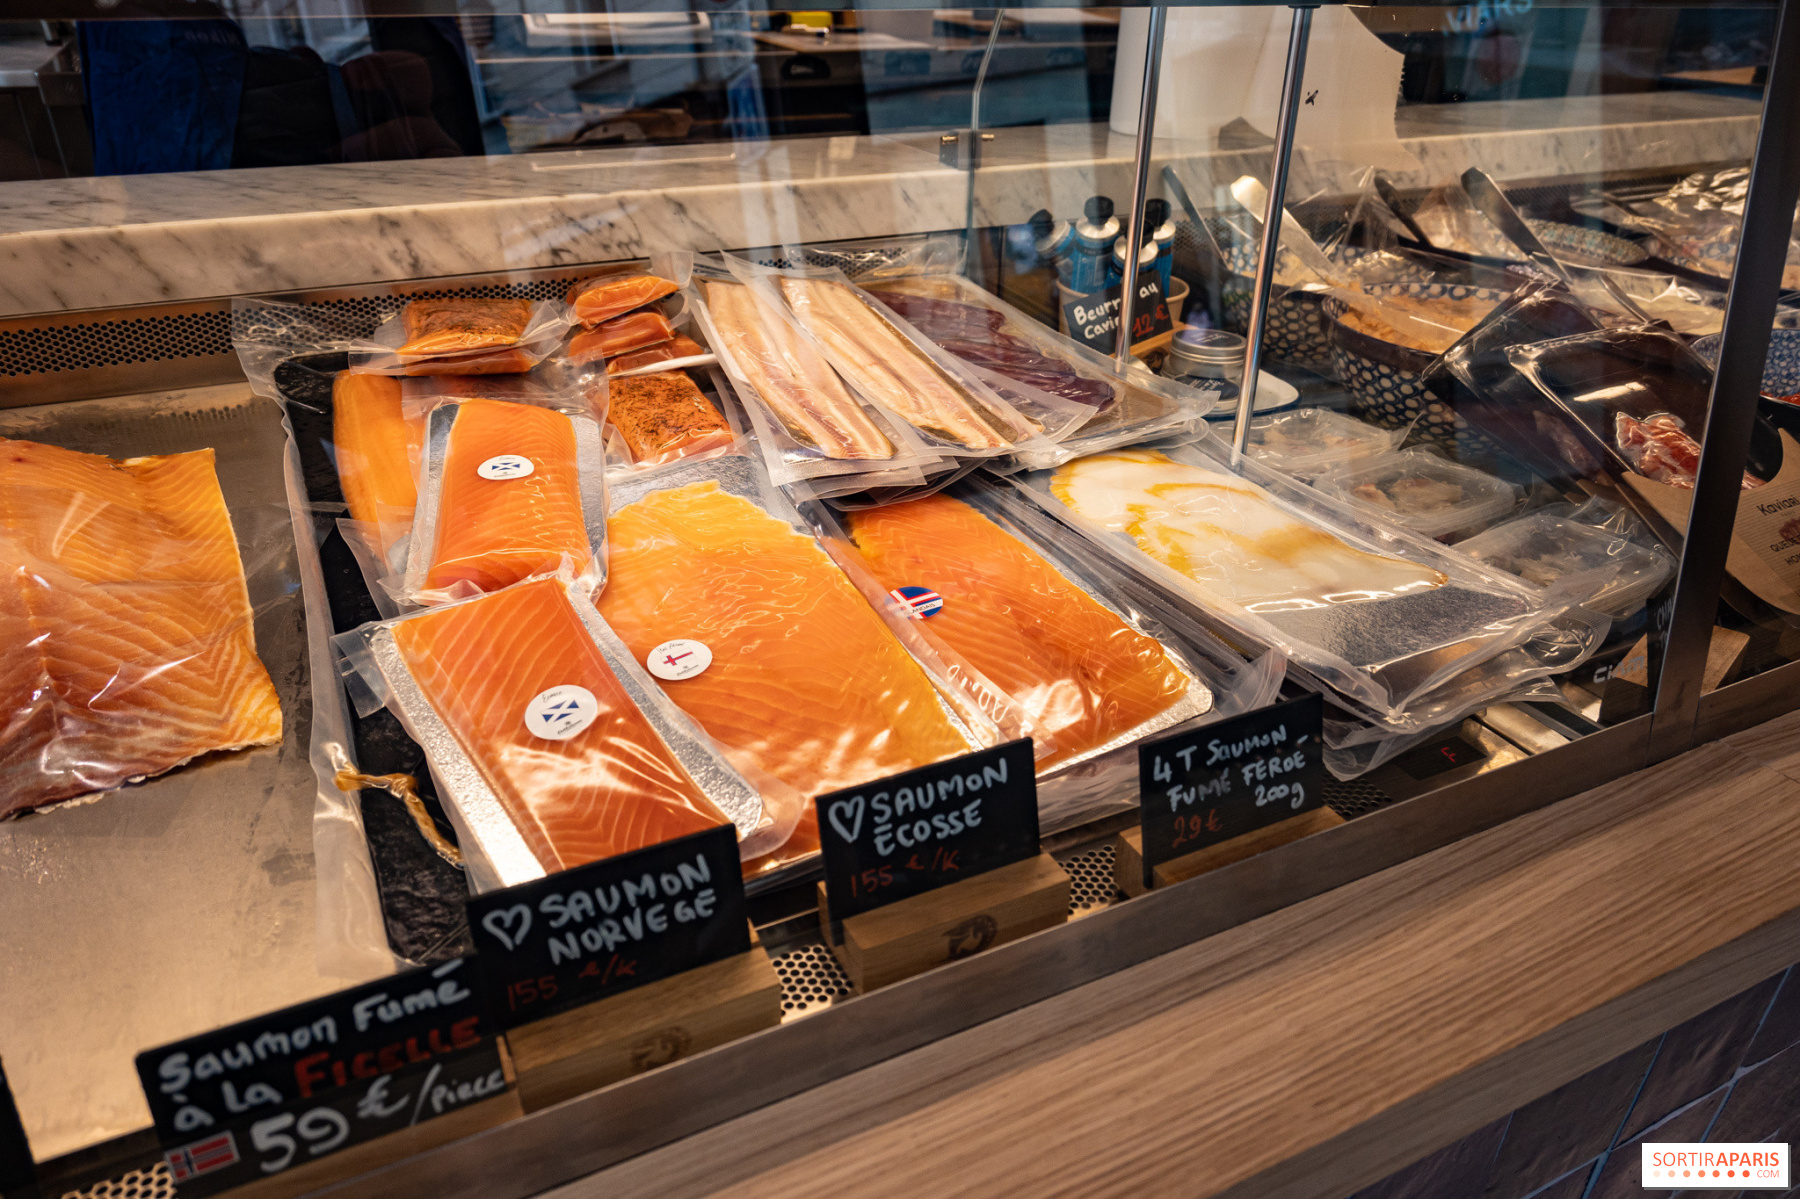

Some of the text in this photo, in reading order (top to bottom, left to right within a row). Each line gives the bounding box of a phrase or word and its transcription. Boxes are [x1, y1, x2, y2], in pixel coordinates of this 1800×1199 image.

[1073, 282, 1159, 326] Beurr au
[1084, 316, 1121, 340] Cavi
[1153, 755, 1172, 783] 4
[1176, 745, 1198, 772] T
[871, 757, 1008, 824] SAUMON
[1254, 782, 1305, 810] 200g
[539, 853, 712, 929] SAUMON
[850, 864, 893, 898] 155
[508, 976, 559, 1011] 155
[250, 1107, 349, 1173] 59
